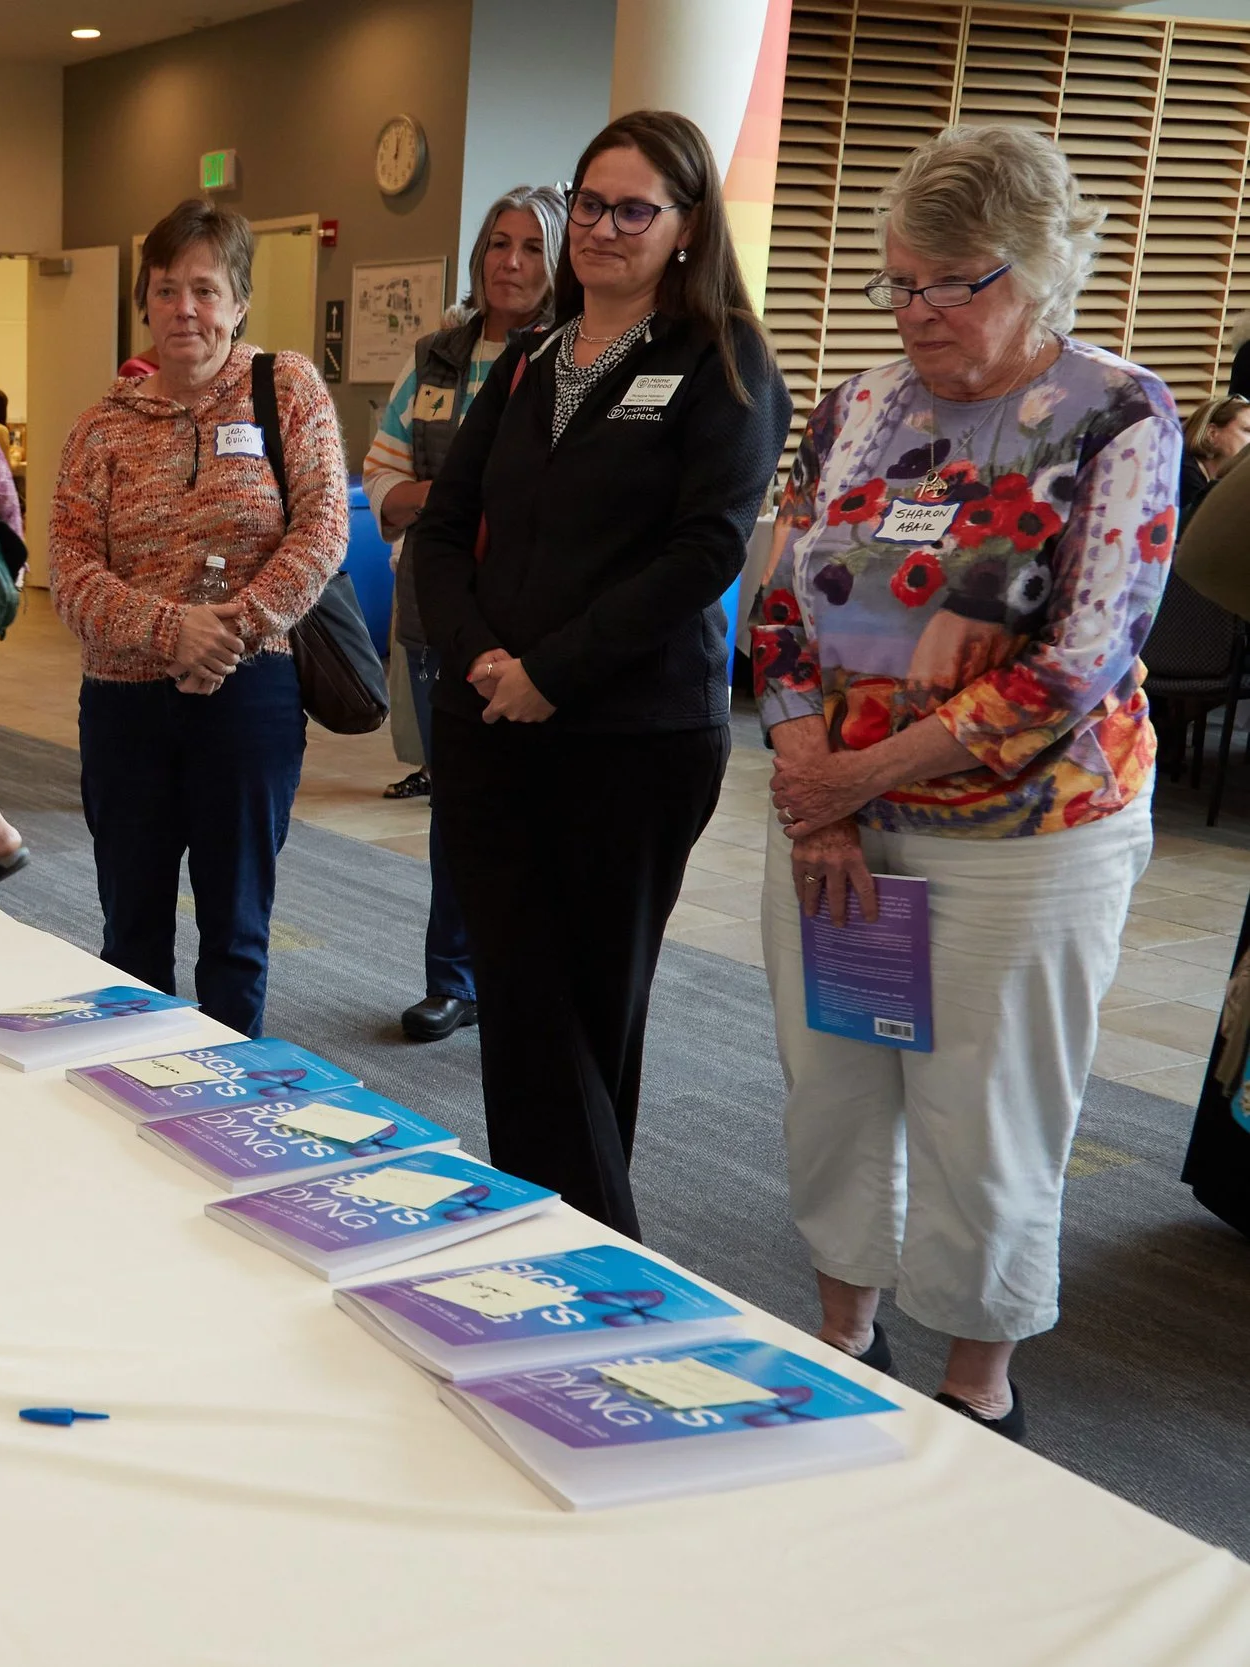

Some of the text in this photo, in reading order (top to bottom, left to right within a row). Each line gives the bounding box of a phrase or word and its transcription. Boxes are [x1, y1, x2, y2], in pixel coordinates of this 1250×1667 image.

[225, 436, 253, 446] Quinn
[895, 507, 950, 519] SHARON
[896, 521, 935, 532] ABAIR
[185, 1050, 248, 1080] SIGN
[197, 1112, 288, 1158] DYING
[268, 1187, 377, 1230] DYING
[523, 1369, 654, 1427] DYING
